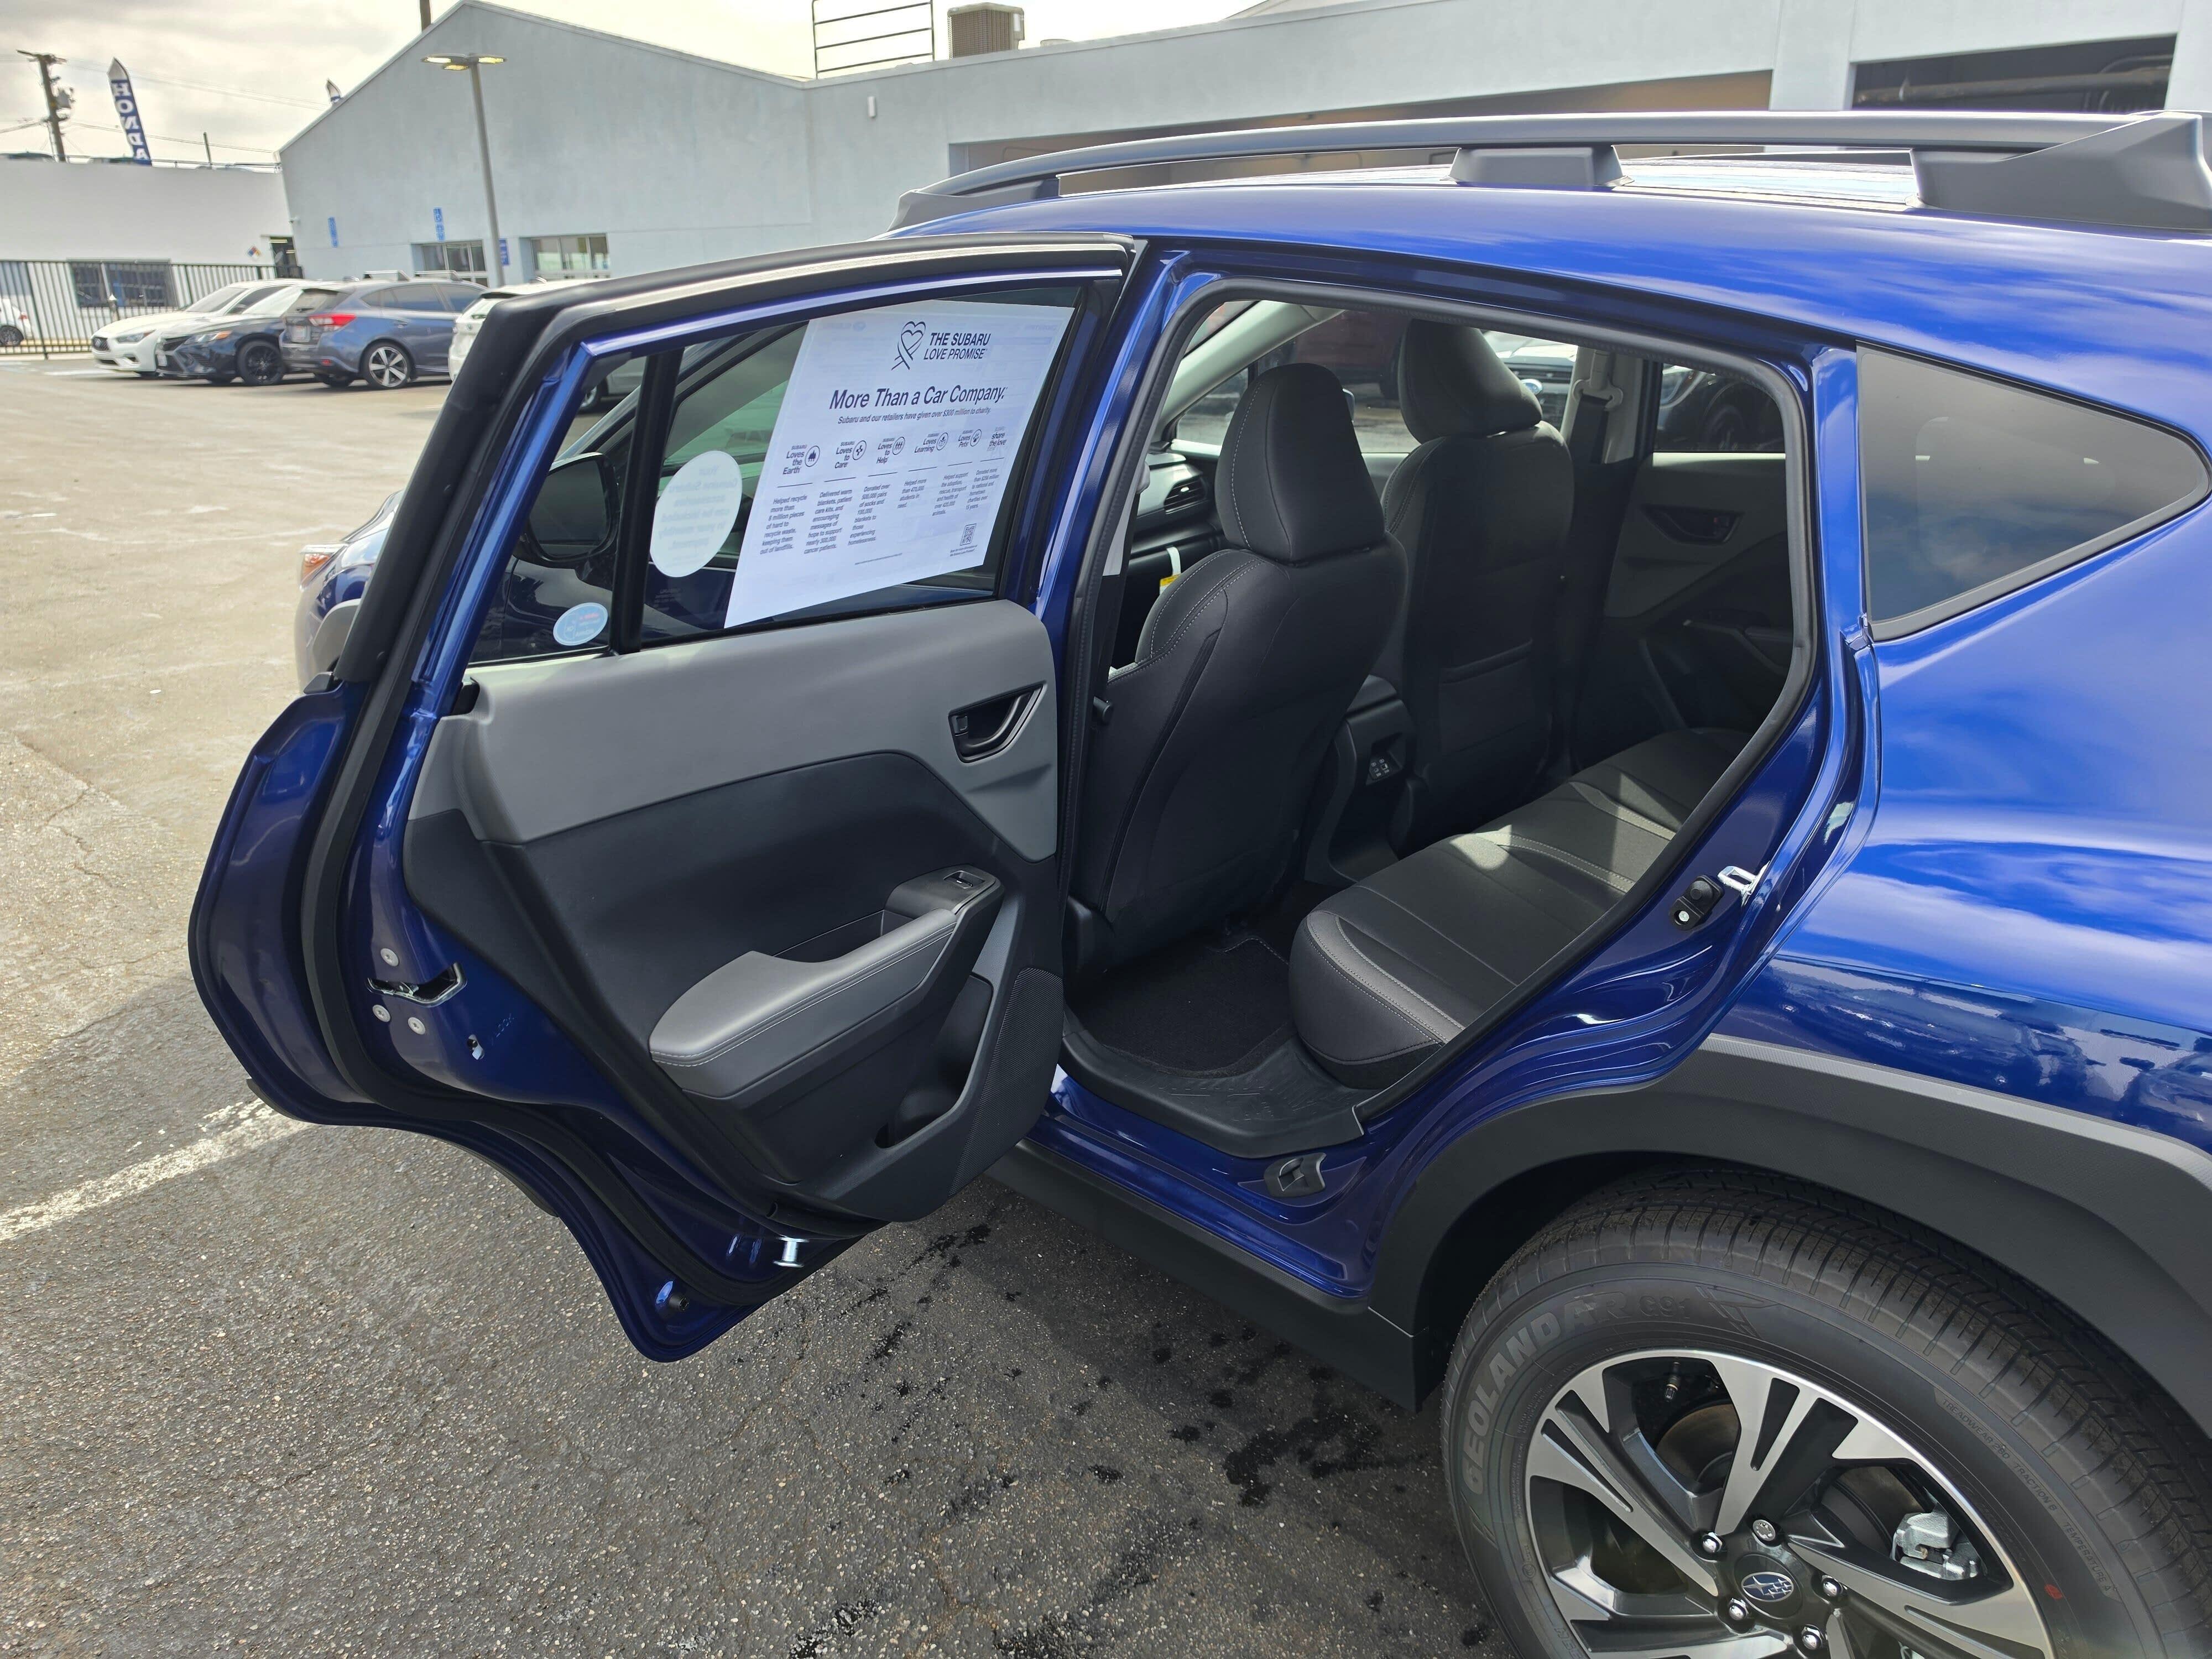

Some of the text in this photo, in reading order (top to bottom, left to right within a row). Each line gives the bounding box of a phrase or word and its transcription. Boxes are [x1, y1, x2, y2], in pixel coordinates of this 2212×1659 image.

[930, 332, 991, 346] THE SUBARU
[924, 348, 985, 360] LOVE PROMISE
[830, 385, 1005, 409] More Than a Car Company.
[838, 416, 858, 424] Subaru
[859, 414, 871, 422] and
[881, 413, 903, 421] retailers
[917, 411, 931, 420] given
[1943, 1399, 1993, 1444] TREADWEAR
[2014, 1463, 2053, 1505] TRACTION
[2065, 1522, 2107, 1583] TEMPERATURE
